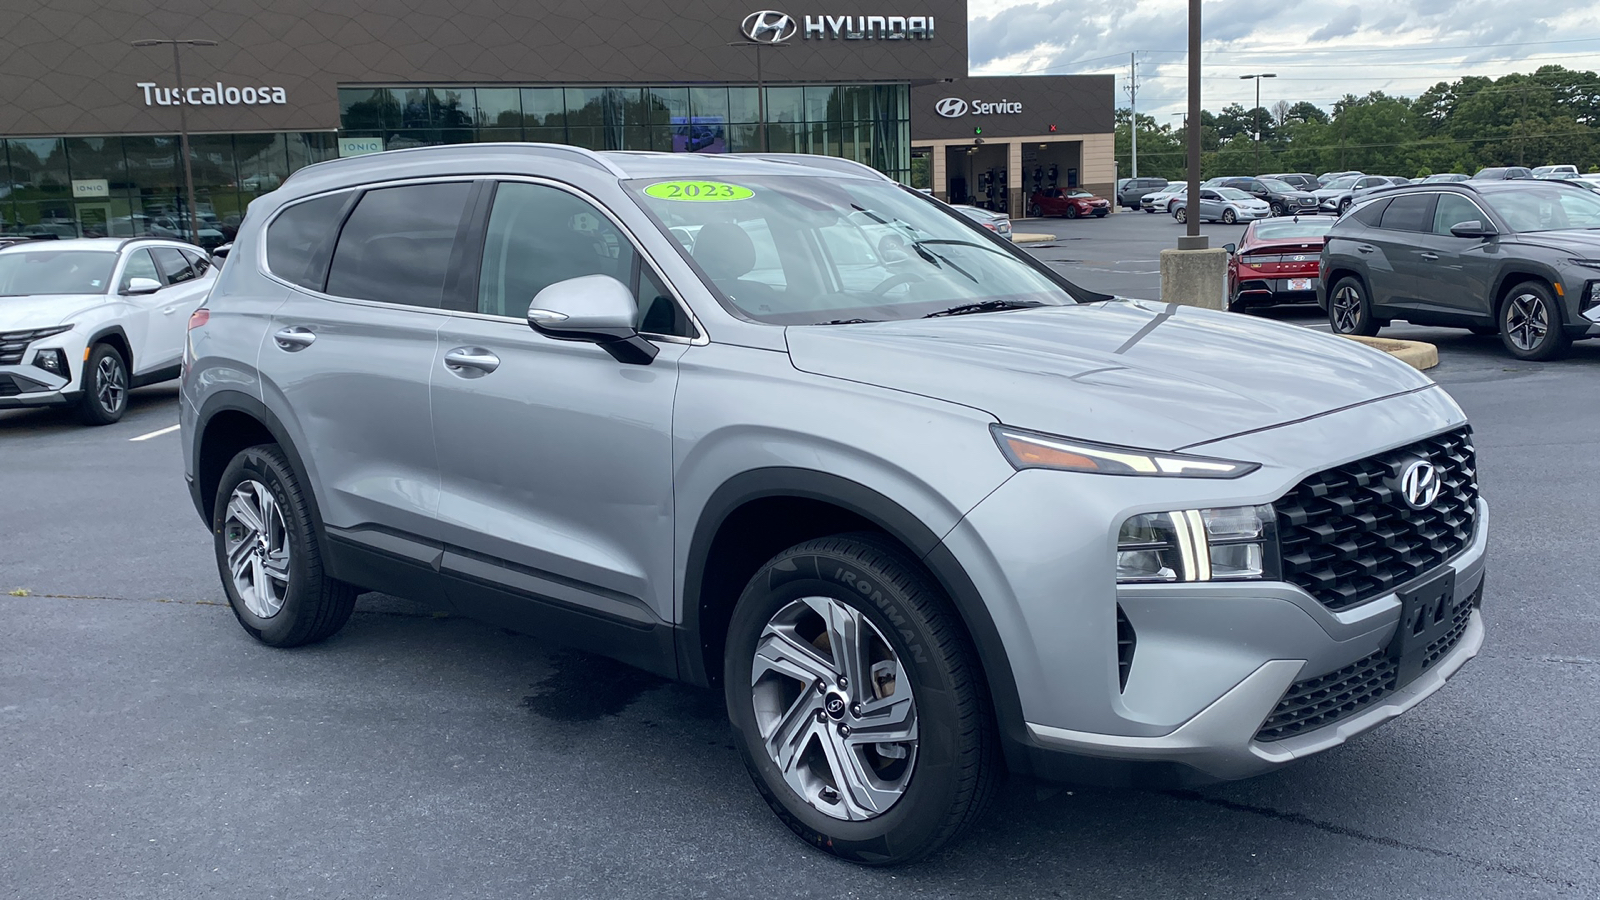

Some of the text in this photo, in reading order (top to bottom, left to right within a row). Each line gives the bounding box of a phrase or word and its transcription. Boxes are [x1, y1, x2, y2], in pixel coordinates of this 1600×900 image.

[803, 15, 935, 40] HYUNDAI
[136, 82, 287, 106] Tuscaloosa
[971, 99, 1022, 115] Service
[666, 184, 735, 198] 2023
[834, 567, 928, 664] IRONMAN
